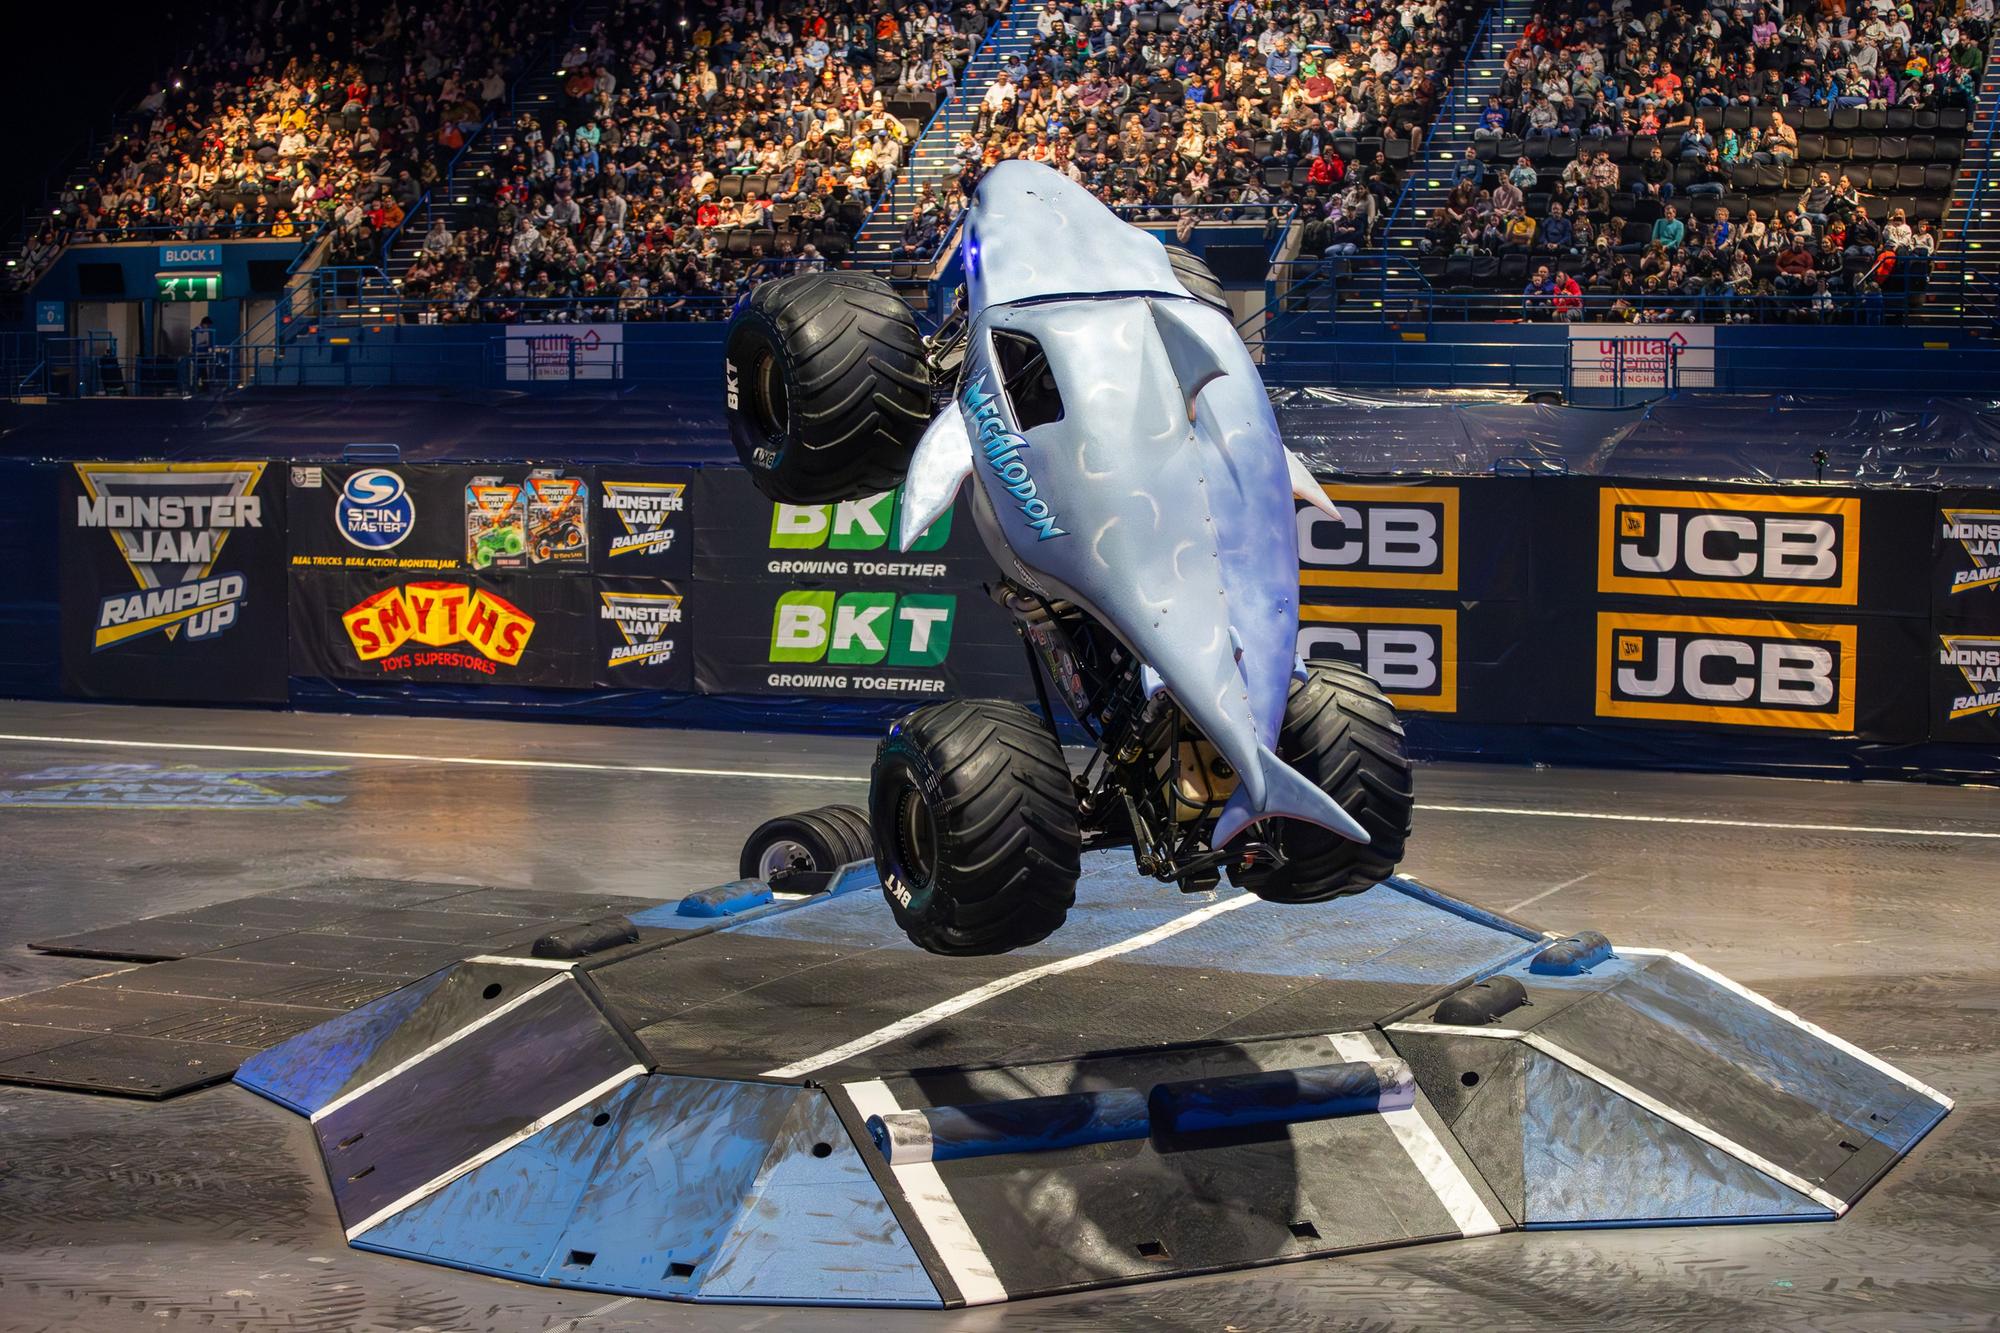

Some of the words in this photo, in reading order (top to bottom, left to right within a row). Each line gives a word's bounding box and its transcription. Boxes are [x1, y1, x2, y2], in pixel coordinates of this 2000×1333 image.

[166, 250, 206, 262] BLOCK
[209, 249, 215, 261] 1
[726, 358, 739, 410] BKT
[1600, 375, 1665, 383] BIRINGHAM
[964, 374, 1071, 542] MEGALODON
[78, 496, 262, 528] MONSTER
[602, 495, 683, 511] MONSTER
[347, 509, 401, 522] SPIN
[625, 510, 661, 524] JAM
[612, 529, 674, 549] RAMPED
[1296, 506, 1438, 567] CB
[1942, 523, 2000, 540] MONS
[127, 531, 211, 563] JAM
[648, 540, 671, 554] UP
[1621, 512, 1837, 581] JCB
[1970, 540, 2000, 556] JA
[292, 556, 312, 566] REAL
[345, 557, 365, 567] REAL
[399, 558, 438, 568] MONSTER
[768, 560, 848, 574] GROWING
[853, 562, 946, 577] TOGETHER
[1954, 567, 2000, 585] RAM
[101, 575, 244, 627] RAMPED
[186, 601, 236, 638] UP
[601, 606, 682, 622] MONSTER
[351, 594, 528, 658] SMYTHS
[625, 621, 660, 635] JAM
[775, 604, 949, 653] BKT
[611, 640, 674, 659] RAMPED
[648, 651, 671, 665] UP
[1940, 650, 2000, 666] MONS
[380, 655, 411, 672] TOYS
[415, 653, 497, 675] SUPERSTORES
[1617, 636, 1834, 707] JCB
[768, 674, 847, 688] GROWING
[853, 676, 945, 692] TOGETHER
[1968, 667, 2000, 682] JA
[884, 873, 913, 910] BKT
